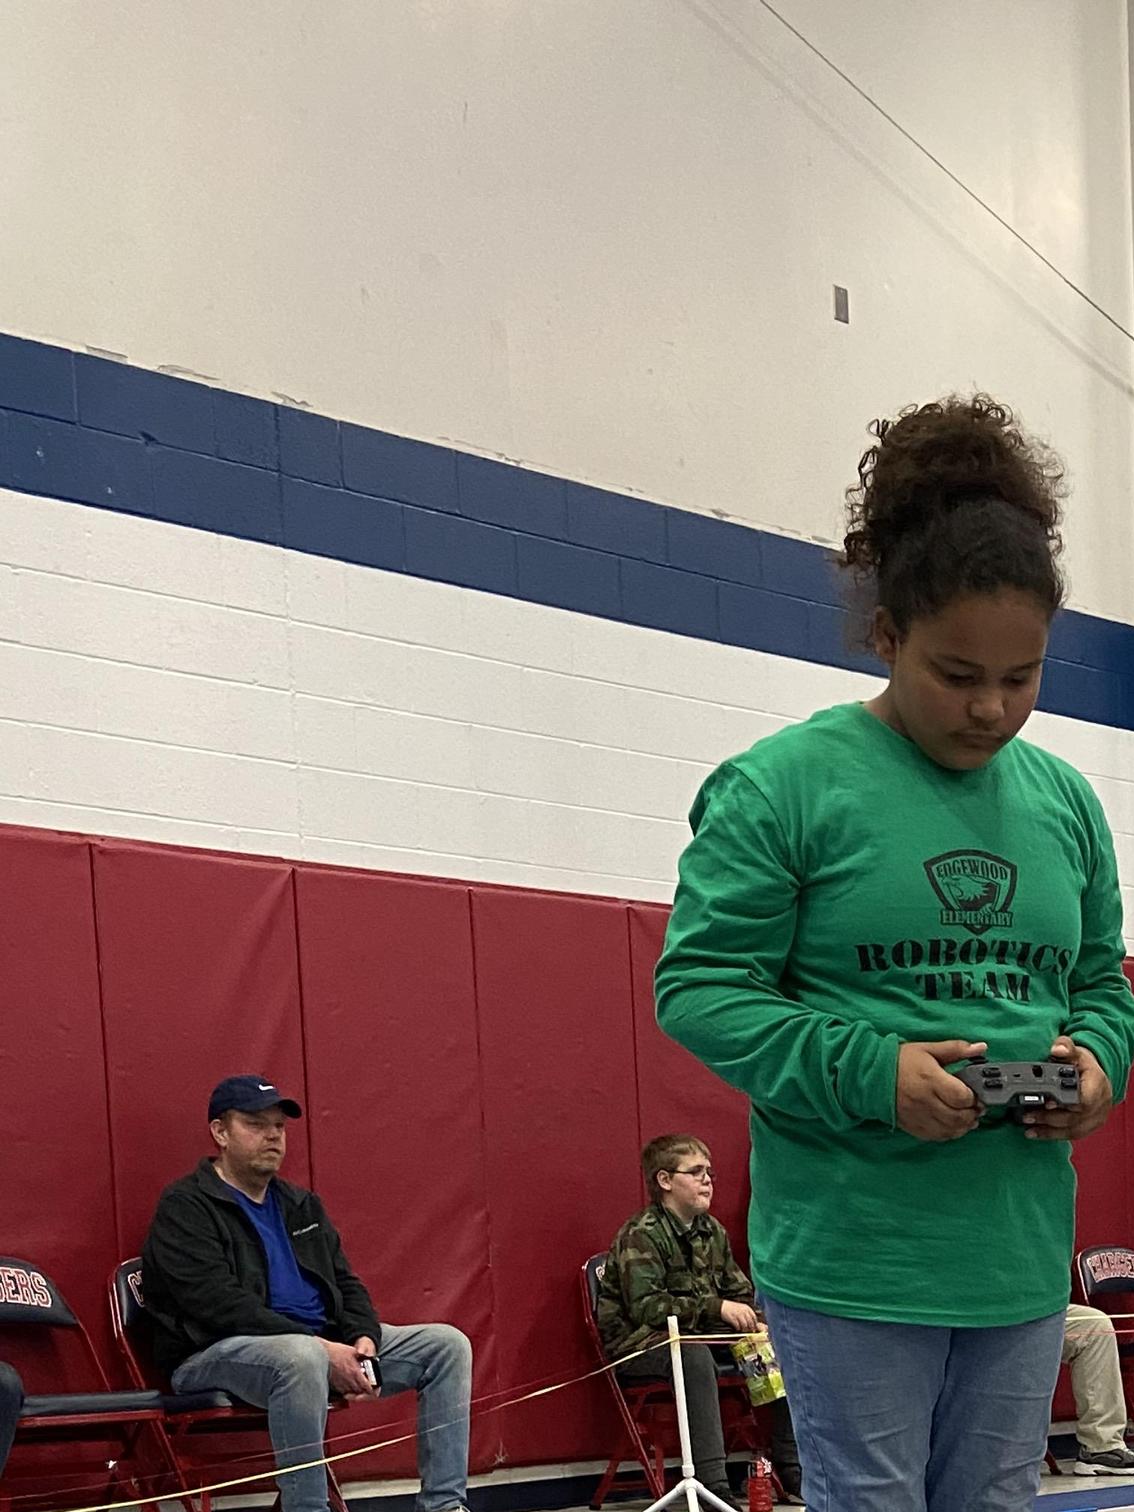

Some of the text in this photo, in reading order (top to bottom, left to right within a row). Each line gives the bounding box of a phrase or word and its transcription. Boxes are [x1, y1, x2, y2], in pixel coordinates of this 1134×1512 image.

[936, 857, 1009, 881] EDGEWOOD
[942, 909, 1013, 927] ELEMENTARY
[855, 938, 1073, 975] ROBOTICS
[915, 971, 1032, 1004] TEAM
[0, 1266, 52, 1308] ERS
